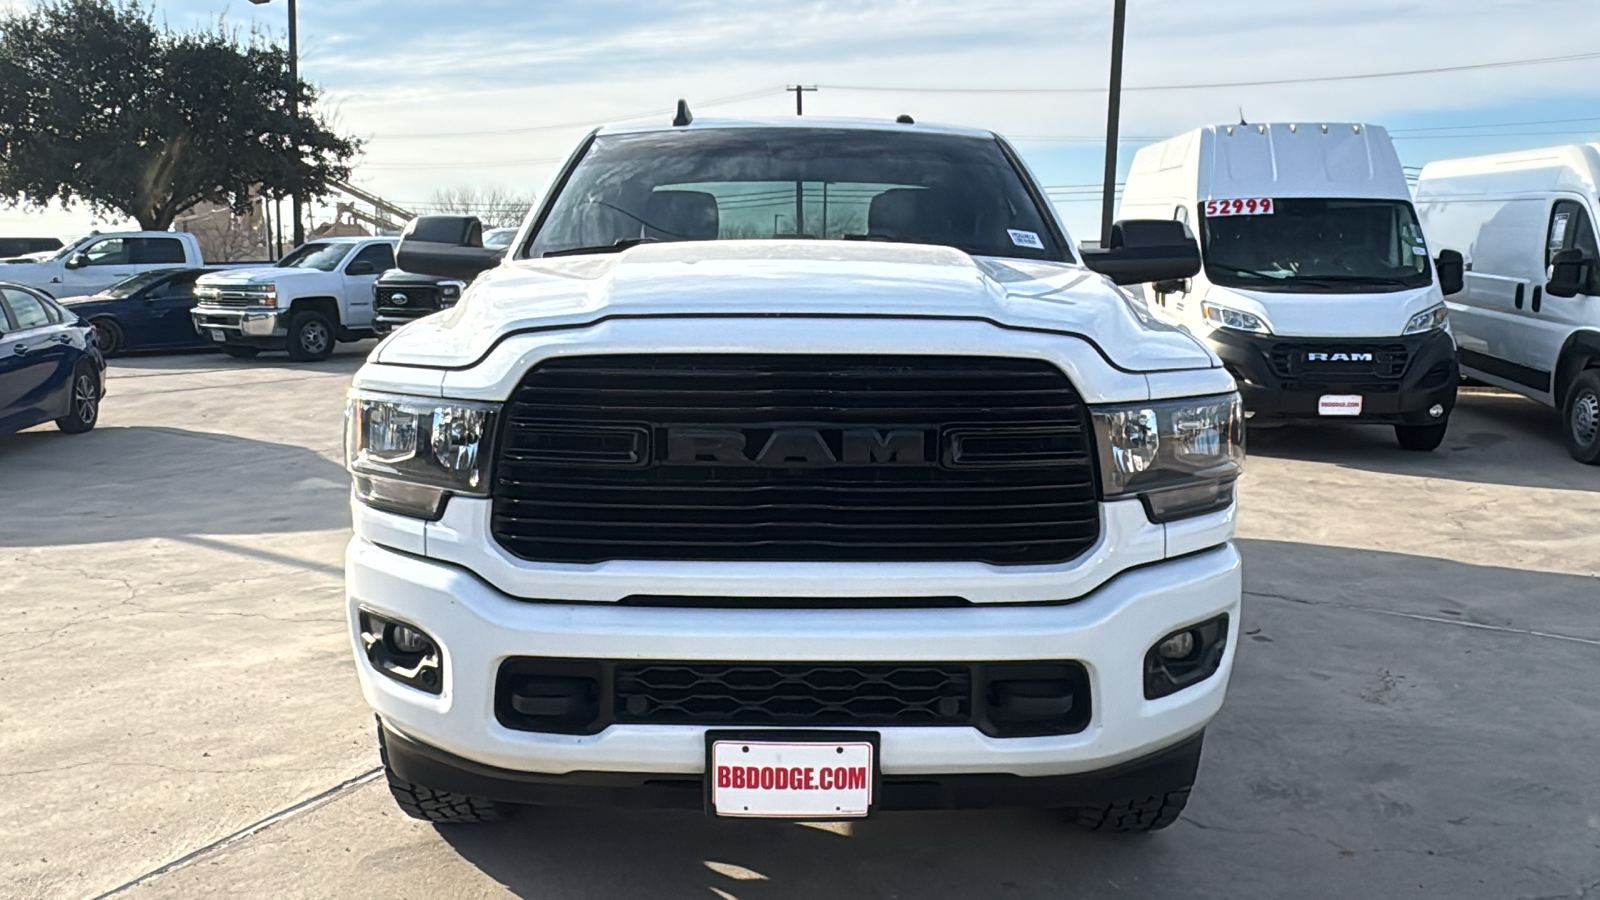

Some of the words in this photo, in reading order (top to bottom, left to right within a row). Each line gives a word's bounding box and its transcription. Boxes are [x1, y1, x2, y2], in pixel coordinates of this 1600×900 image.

[1207, 198, 1271, 215] 52999
[1308, 353, 1372, 361] RAM
[667, 428, 924, 462] RAM
[717, 765, 866, 790] BBDODGE.COM
